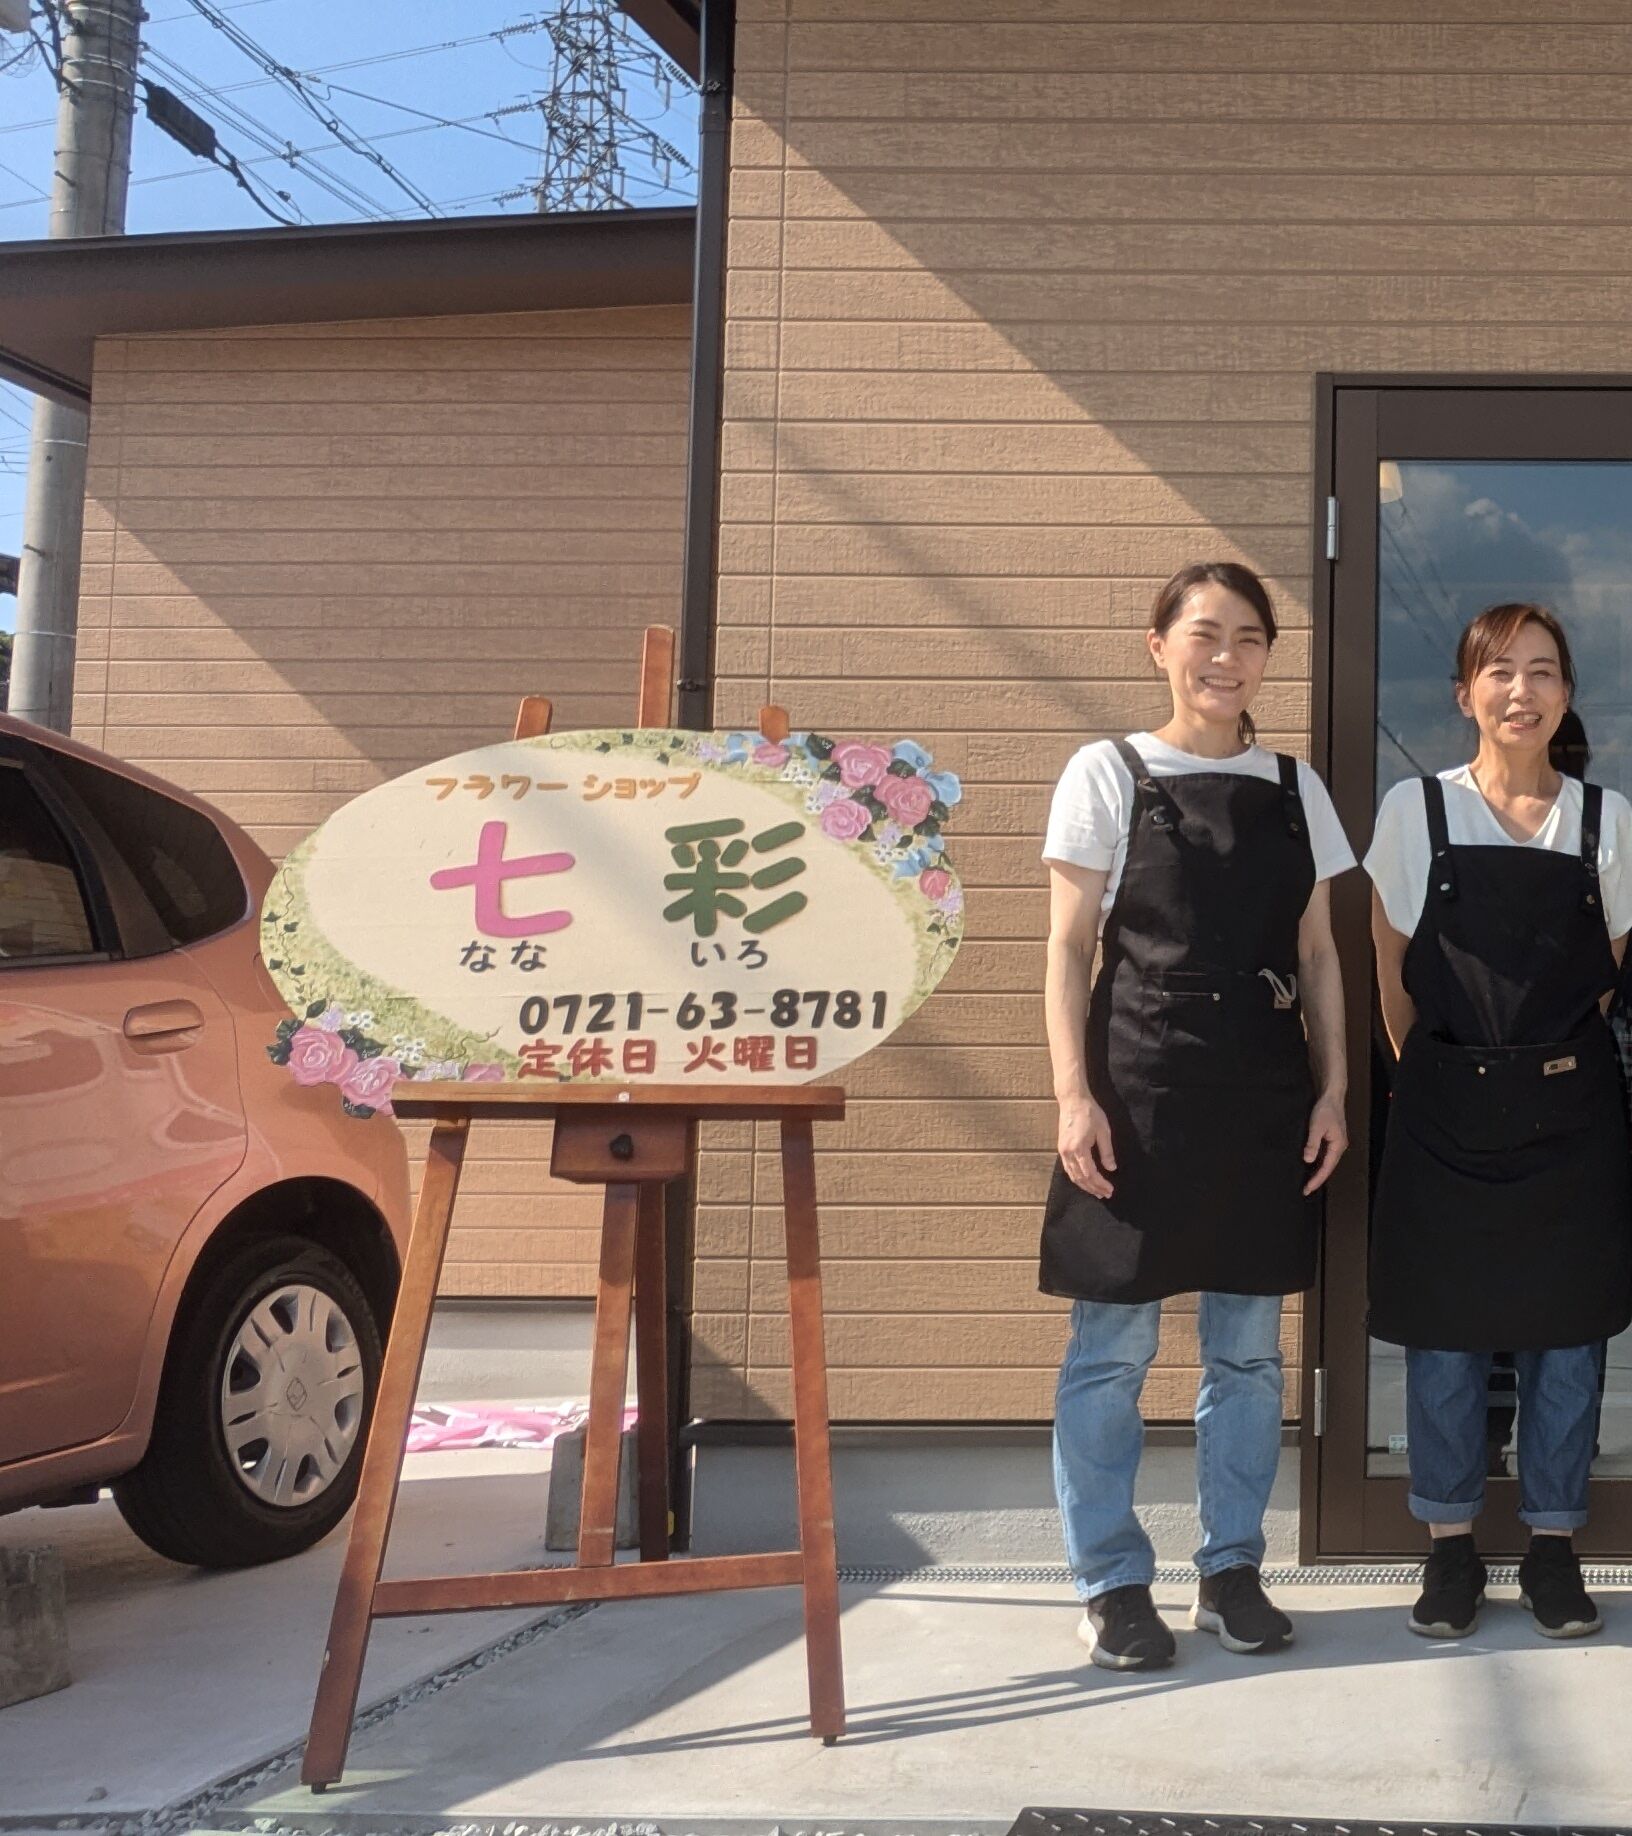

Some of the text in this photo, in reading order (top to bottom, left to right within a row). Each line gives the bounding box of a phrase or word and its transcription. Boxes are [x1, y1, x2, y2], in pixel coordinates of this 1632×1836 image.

[425, 771, 702, 801] フラワー ショップ
[429, 817, 808, 938] 七 彩
[459, 939, 769, 973] なな いろ
[518, 988, 888, 1035] 0721-63-8781
[517, 1035, 818, 1079] 定休日 火曜日
